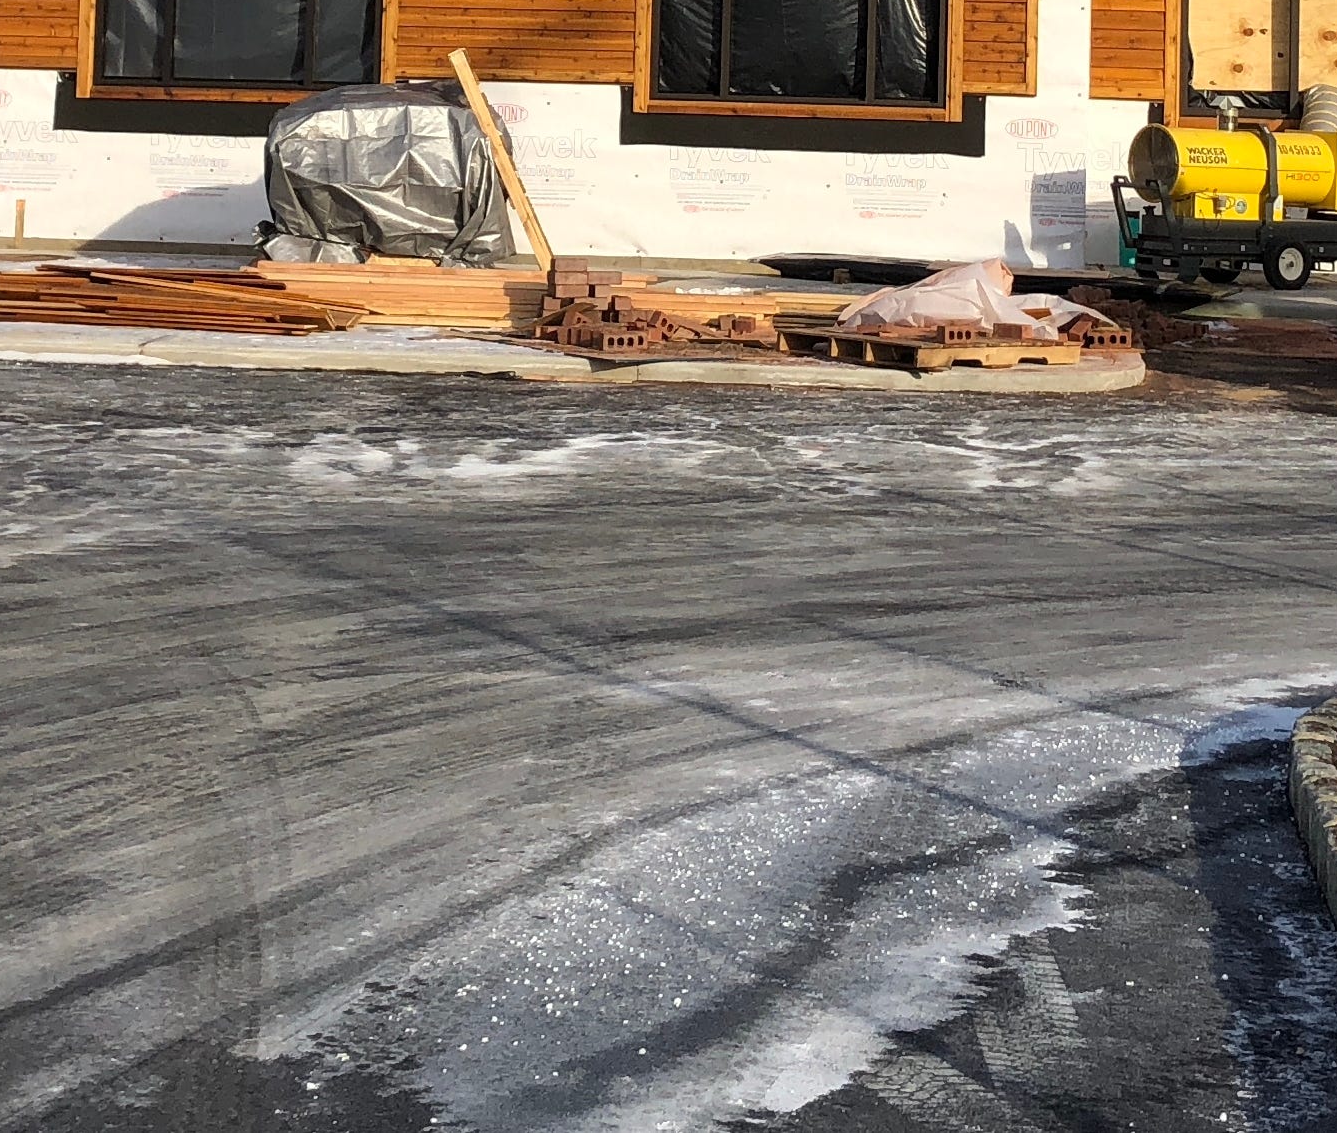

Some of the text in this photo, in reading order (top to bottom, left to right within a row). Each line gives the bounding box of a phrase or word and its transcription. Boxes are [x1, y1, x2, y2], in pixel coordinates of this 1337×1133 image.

[1010, 121, 1055, 138] DUPONT
[511, 128, 598, 165] yvek
[1187, 147, 1226, 156] WACKER
[1189, 155, 1228, 164] NEUSON
[845, 172, 927, 191] DrainWrap
